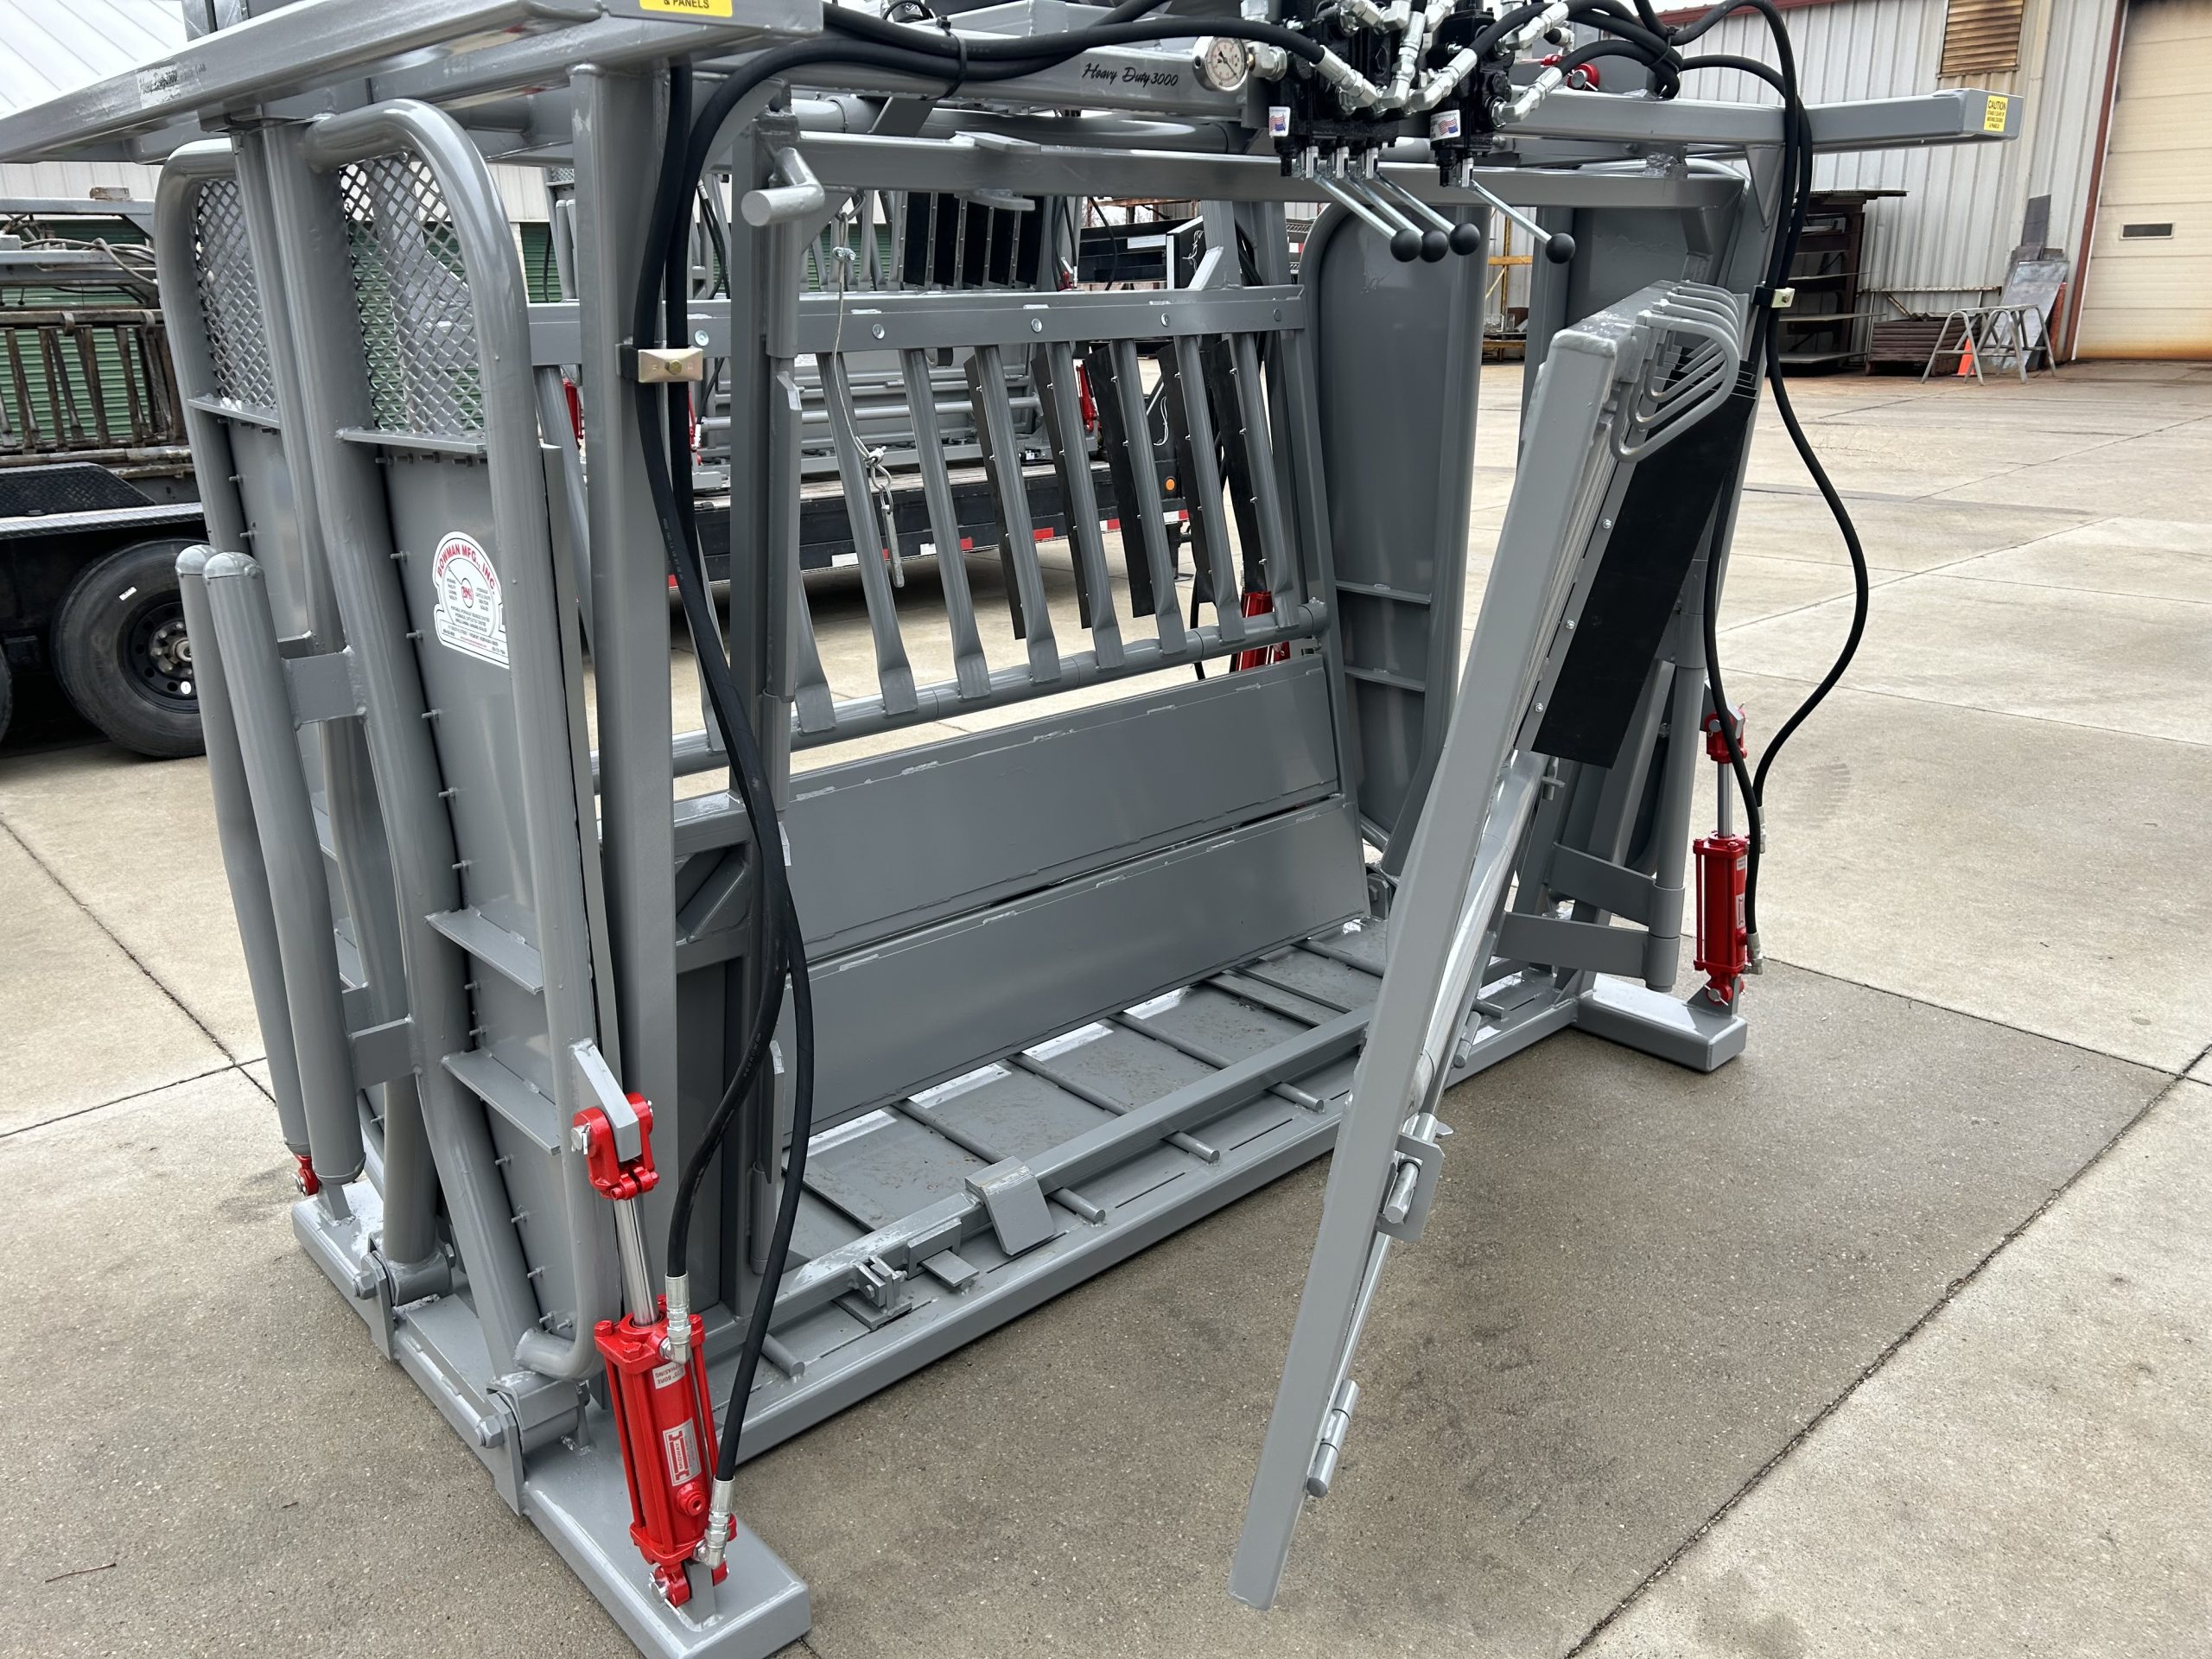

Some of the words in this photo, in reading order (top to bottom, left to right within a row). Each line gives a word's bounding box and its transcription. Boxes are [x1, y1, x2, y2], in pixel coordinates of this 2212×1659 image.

[673, 0, 709, 9] PANELS
[1082, 62, 1118, 86] Heavy
[1122, 67, 1151, 88] Duty
[1150, 73, 1179, 86] 3000
[1988, 100, 2006, 110] CAUTION
[437, 543, 461, 578] BOWMAN
[657, 1375, 672, 1384] BORE
[675, 1443, 684, 1469] MIDWAY
